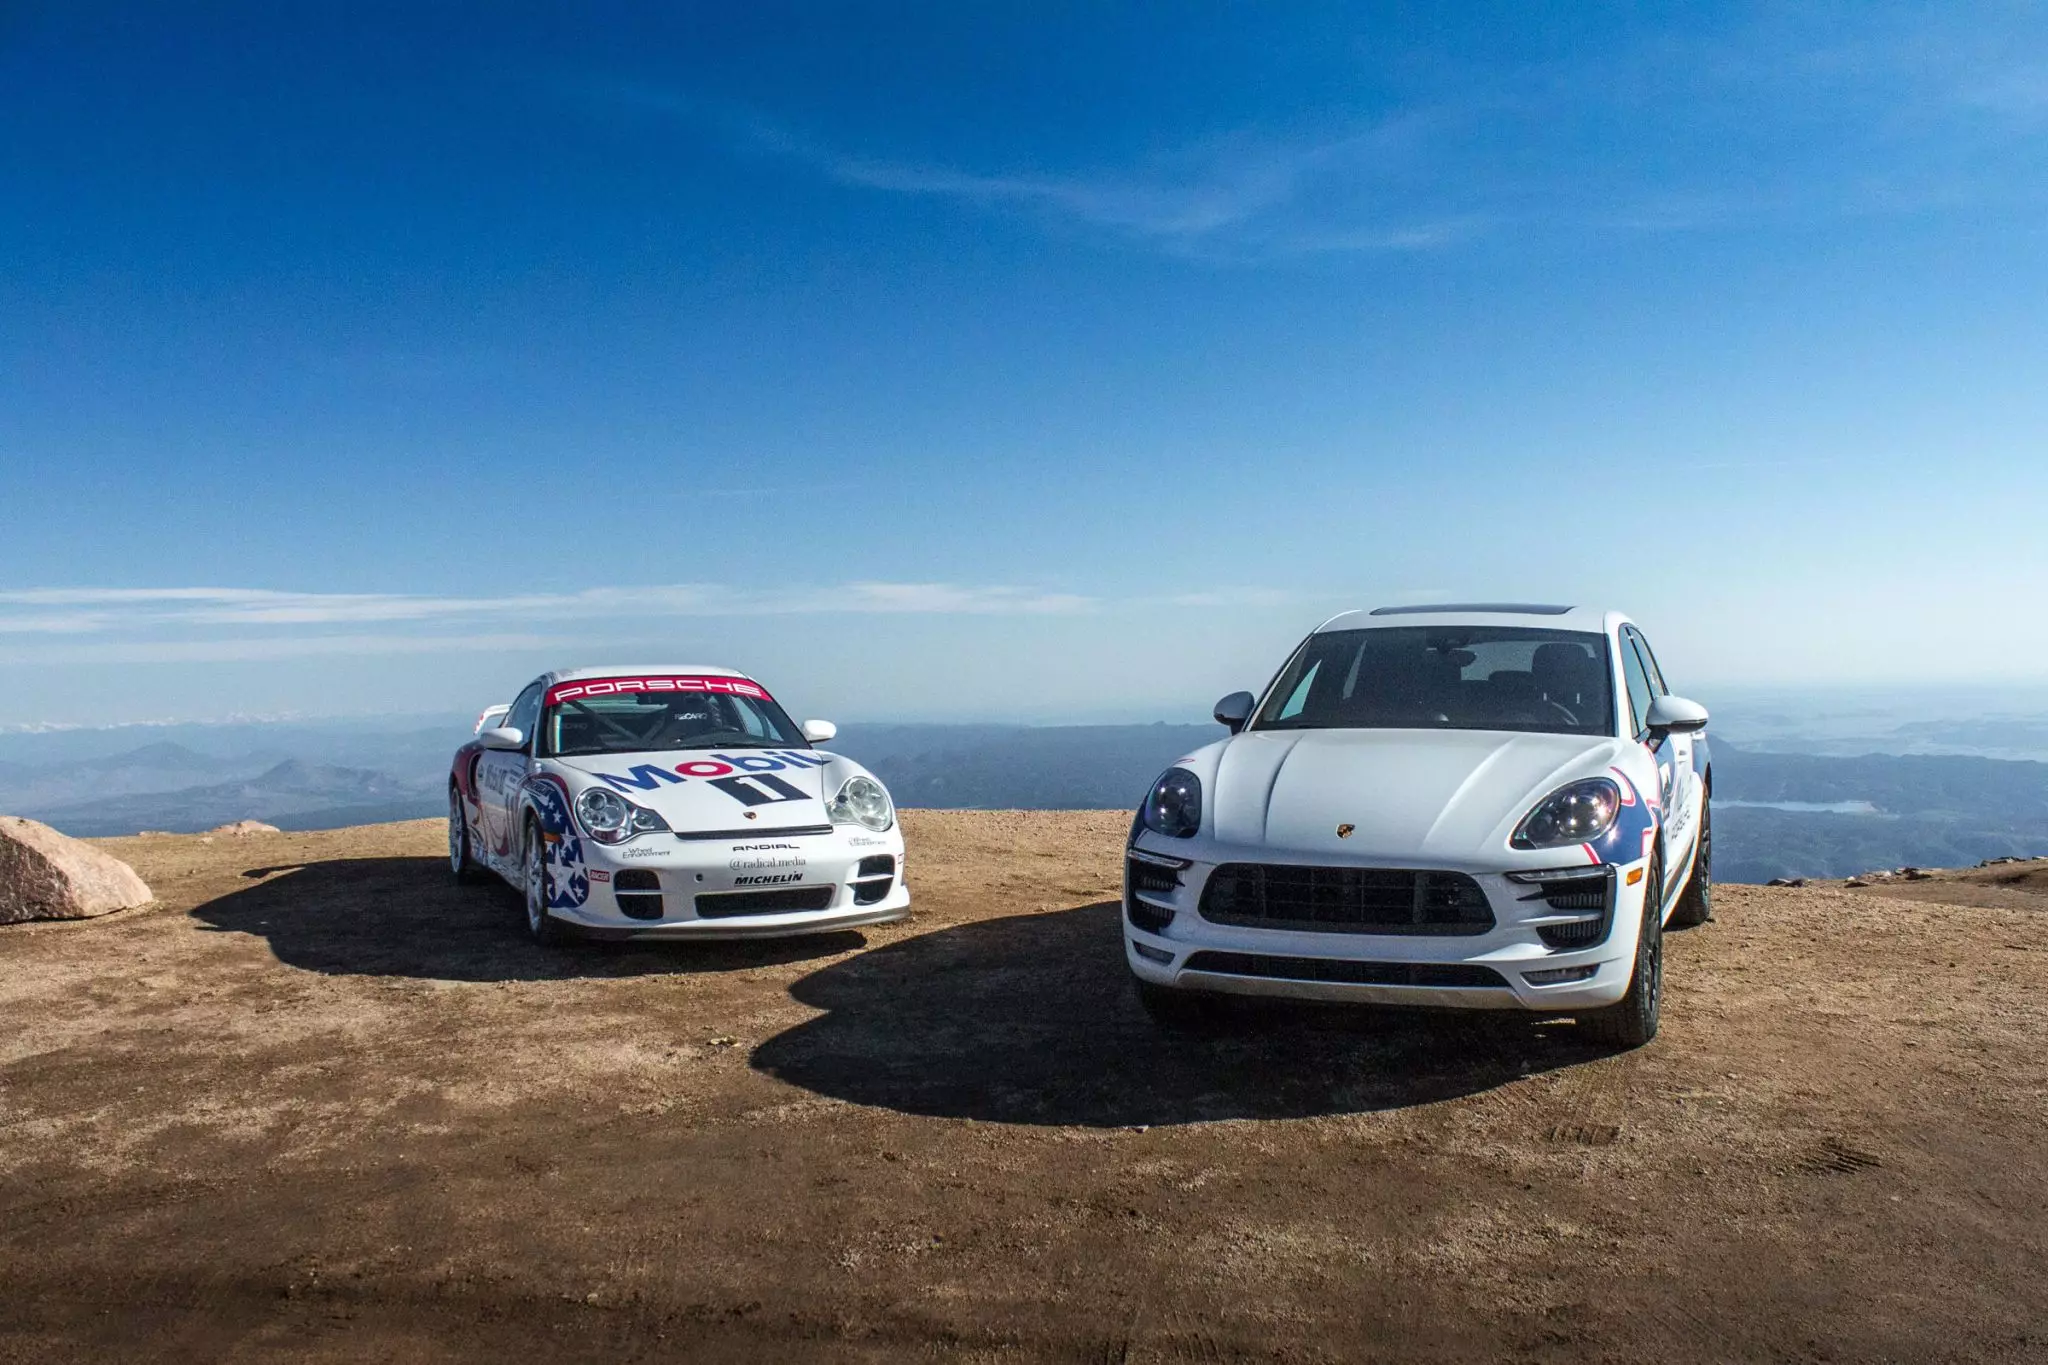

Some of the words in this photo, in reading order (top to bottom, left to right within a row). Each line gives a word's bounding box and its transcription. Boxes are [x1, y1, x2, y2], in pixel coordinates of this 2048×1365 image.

[555, 680, 762, 701] PORSCHE
[592, 751, 832, 793] Mobil
[735, 873, 803, 884] MICHELIN
